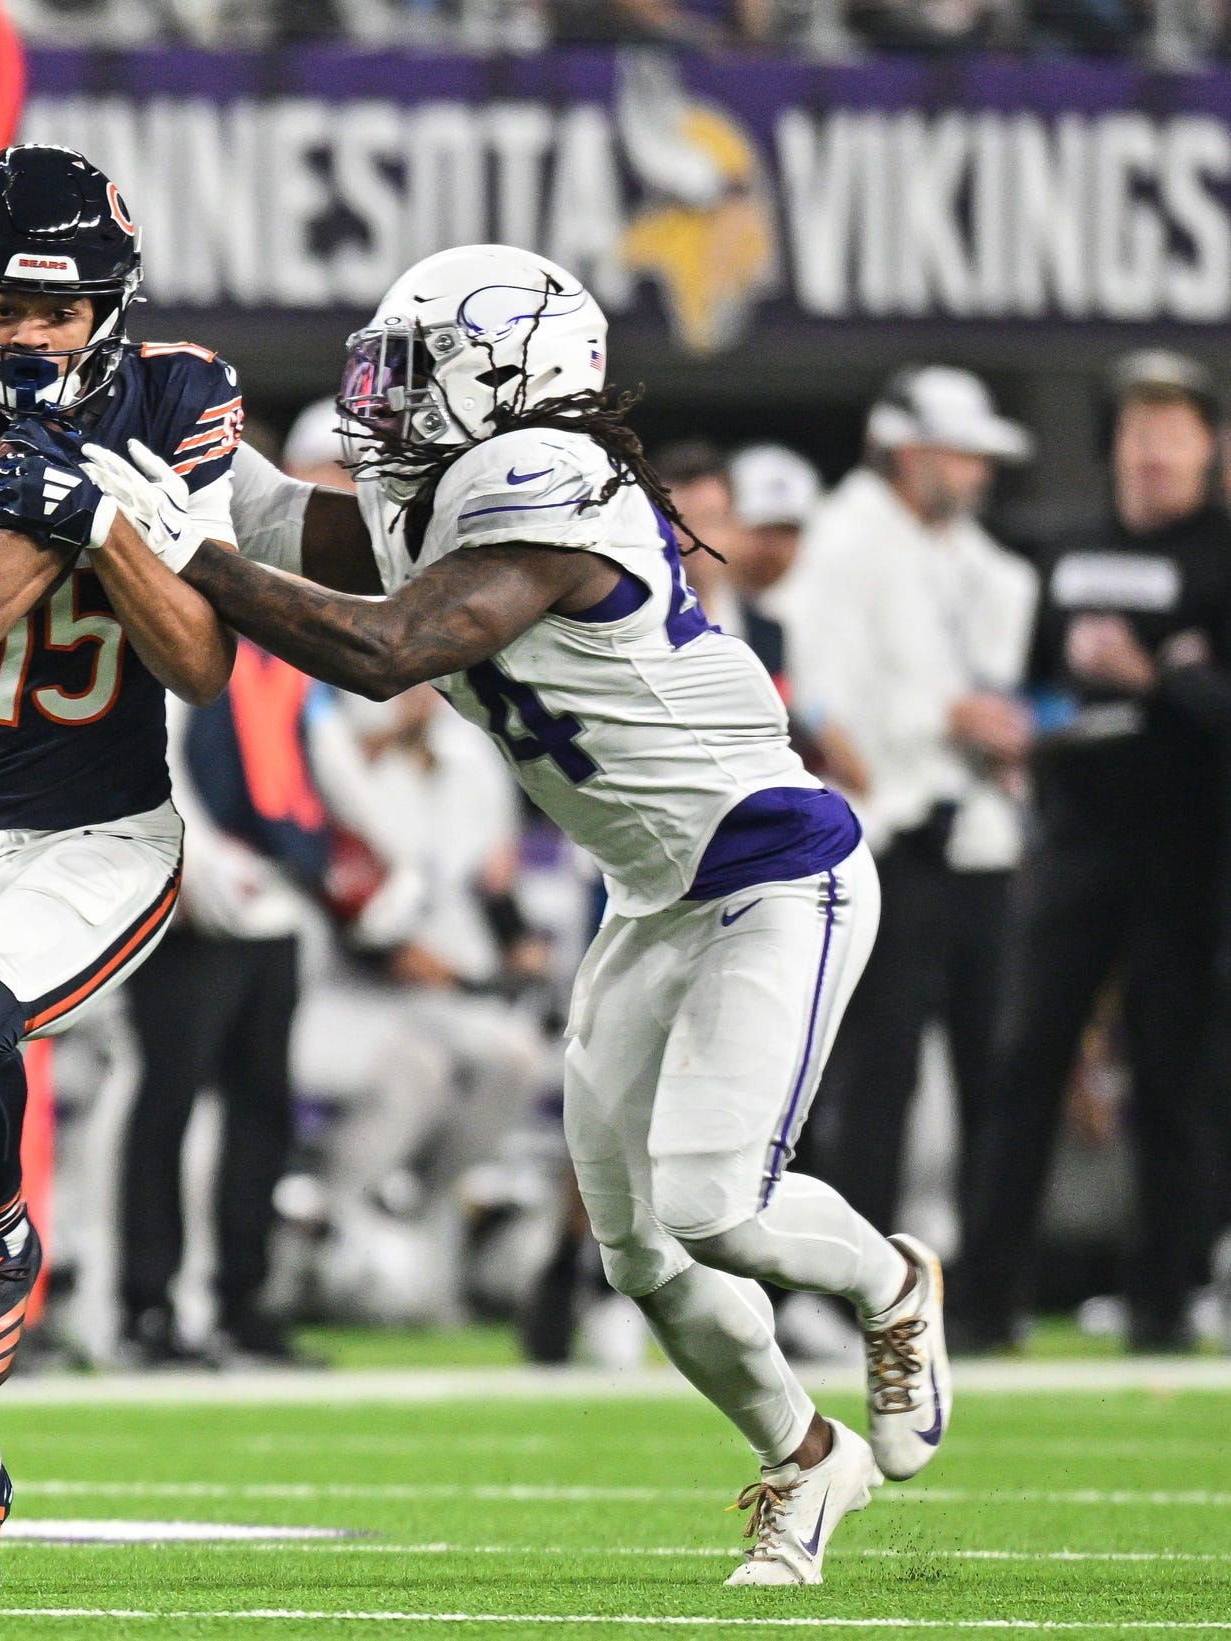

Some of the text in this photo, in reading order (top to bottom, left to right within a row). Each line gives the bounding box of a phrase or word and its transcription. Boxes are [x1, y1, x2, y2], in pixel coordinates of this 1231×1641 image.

[19, 258, 68, 270] BEARS
[26, 97, 1231, 320] NNESOTA VIKINGS
[433, 656, 608, 790] 4
